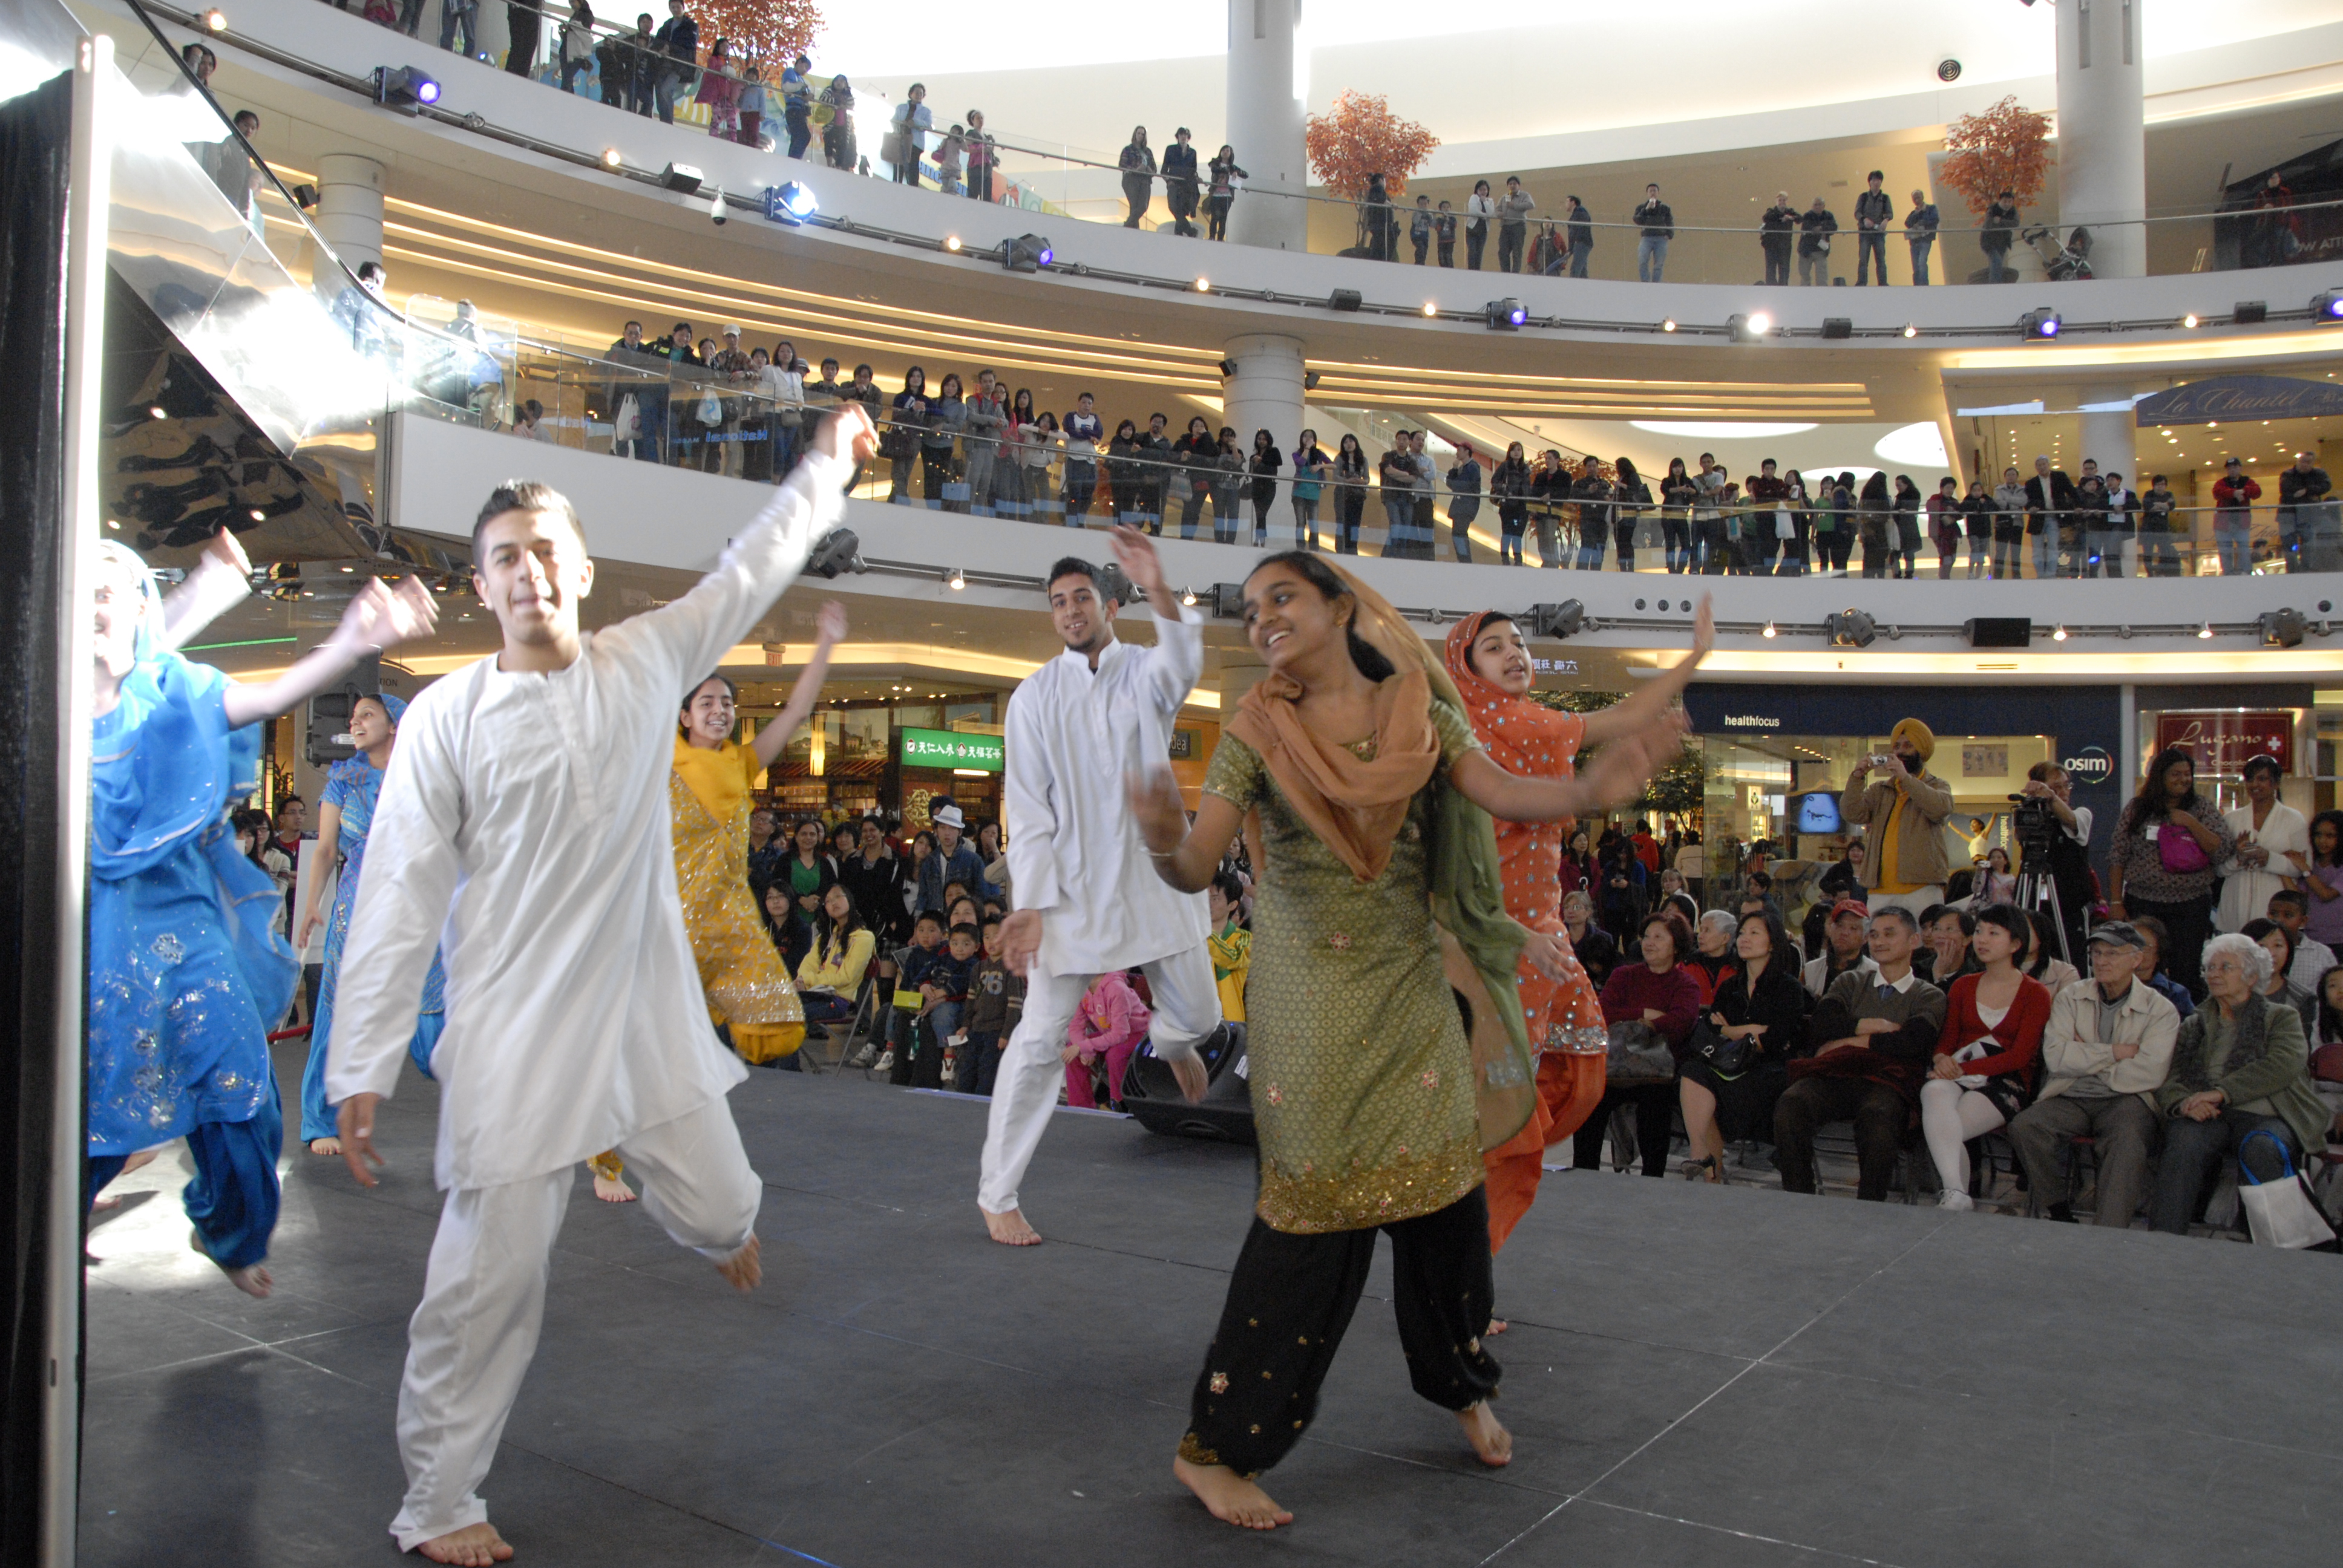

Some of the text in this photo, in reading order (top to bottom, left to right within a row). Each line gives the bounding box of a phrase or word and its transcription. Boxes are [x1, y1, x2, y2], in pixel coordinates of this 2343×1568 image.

[2148, 390, 2195, 417] La
[2197, 387, 2312, 413] Chantel
[768, 653, 781, 667] EXIT
[379, 678, 398, 687] TION
[1725, 715, 1780, 727] healthfocus
[2166, 720, 2263, 756] Lugano
[2001, 815, 2009, 851] healthfoc
